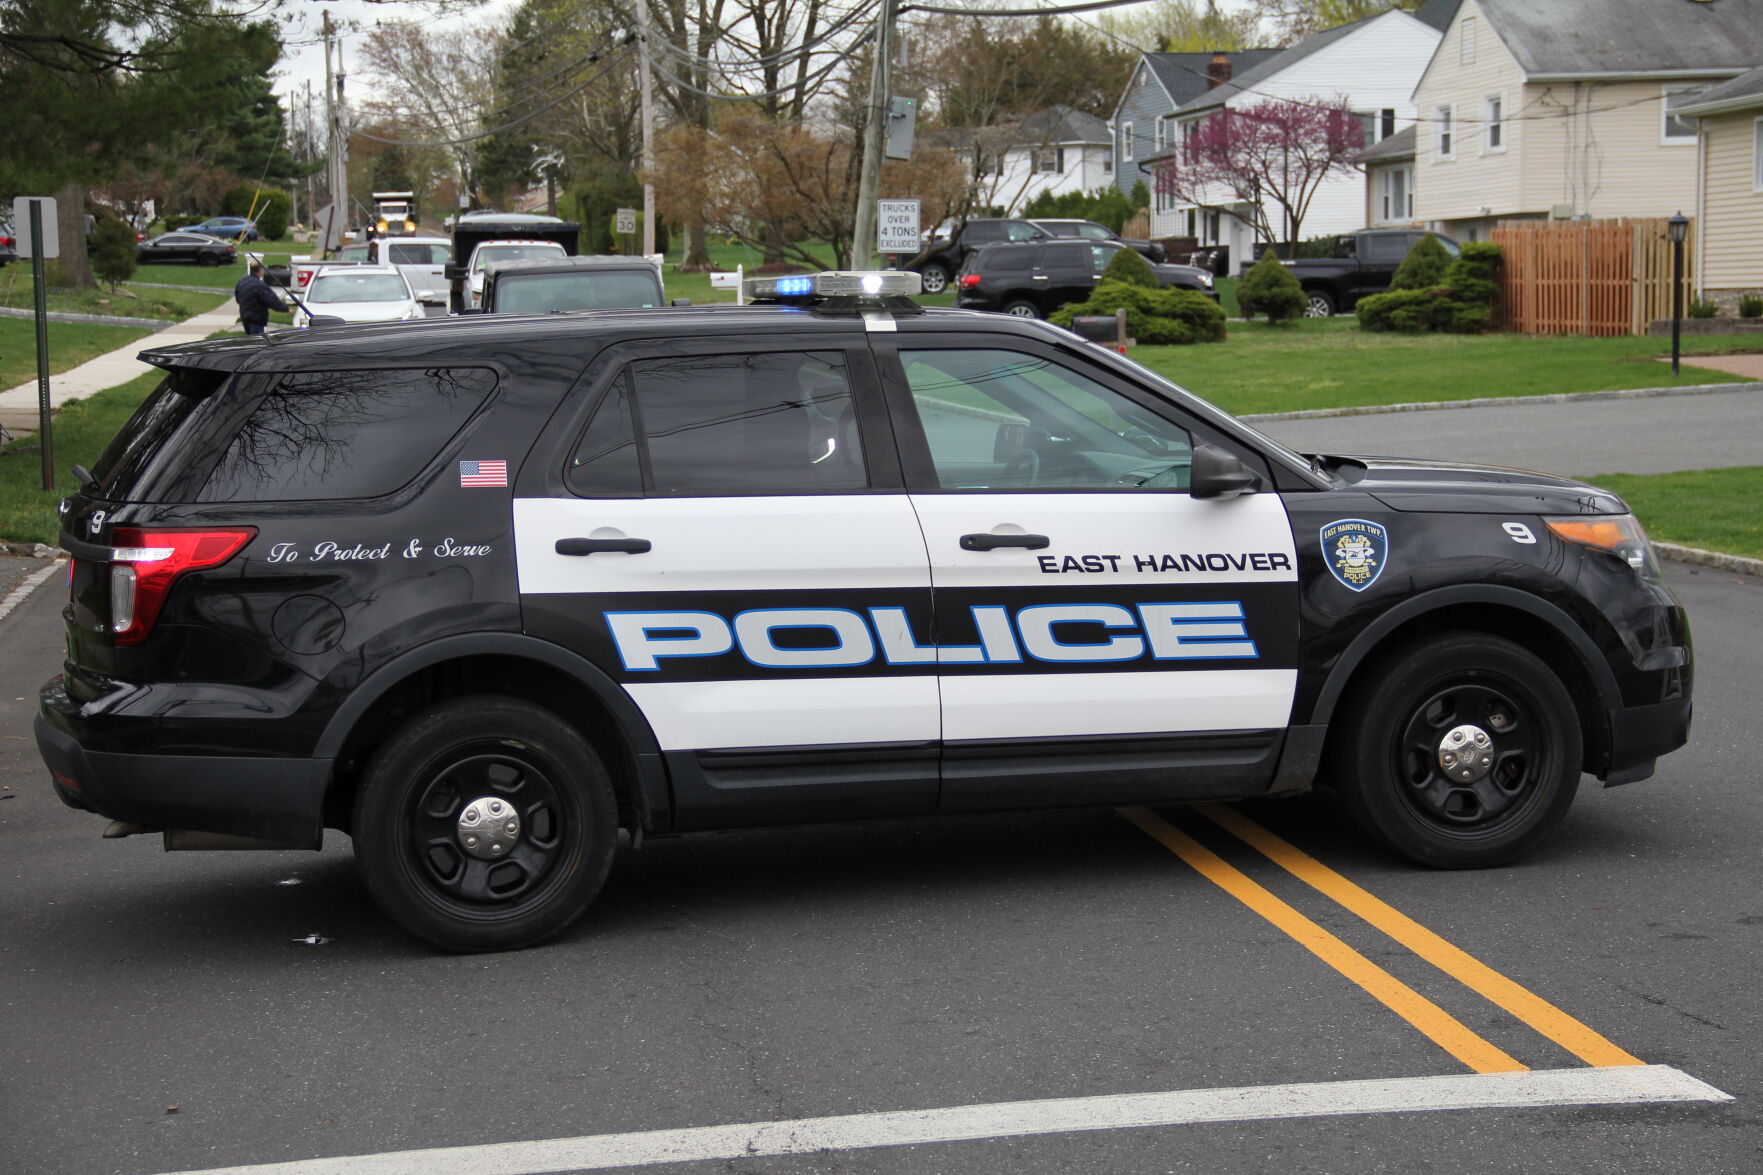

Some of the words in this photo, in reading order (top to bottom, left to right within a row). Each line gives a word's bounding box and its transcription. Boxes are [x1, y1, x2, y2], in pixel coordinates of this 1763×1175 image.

[882, 204, 916, 213] TRUCKS
[619, 221, 634, 231] 30
[887, 215, 910, 224] OVER
[881, 227, 888, 236] 4
[891, 226, 917, 237] TONS
[880, 240, 917, 248] EXCLUDED
[91, 510, 106, 534] 9
[1324, 527, 1337, 539] EAST
[1337, 523, 1366, 532] HANOVER
[1366, 525, 1383, 538] TWP.
[1501, 522, 1537, 544] 9
[267, 542, 298, 563] To
[310, 541, 391, 562] Protect
[403, 538, 423, 558] &
[434, 537, 493, 558] Serve
[1037, 555, 1121, 574] EAST
[1133, 553, 1292, 573] HANOVER
[1343, 572, 1371, 580] POLICE
[603, 600, 1260, 672] POLICE
